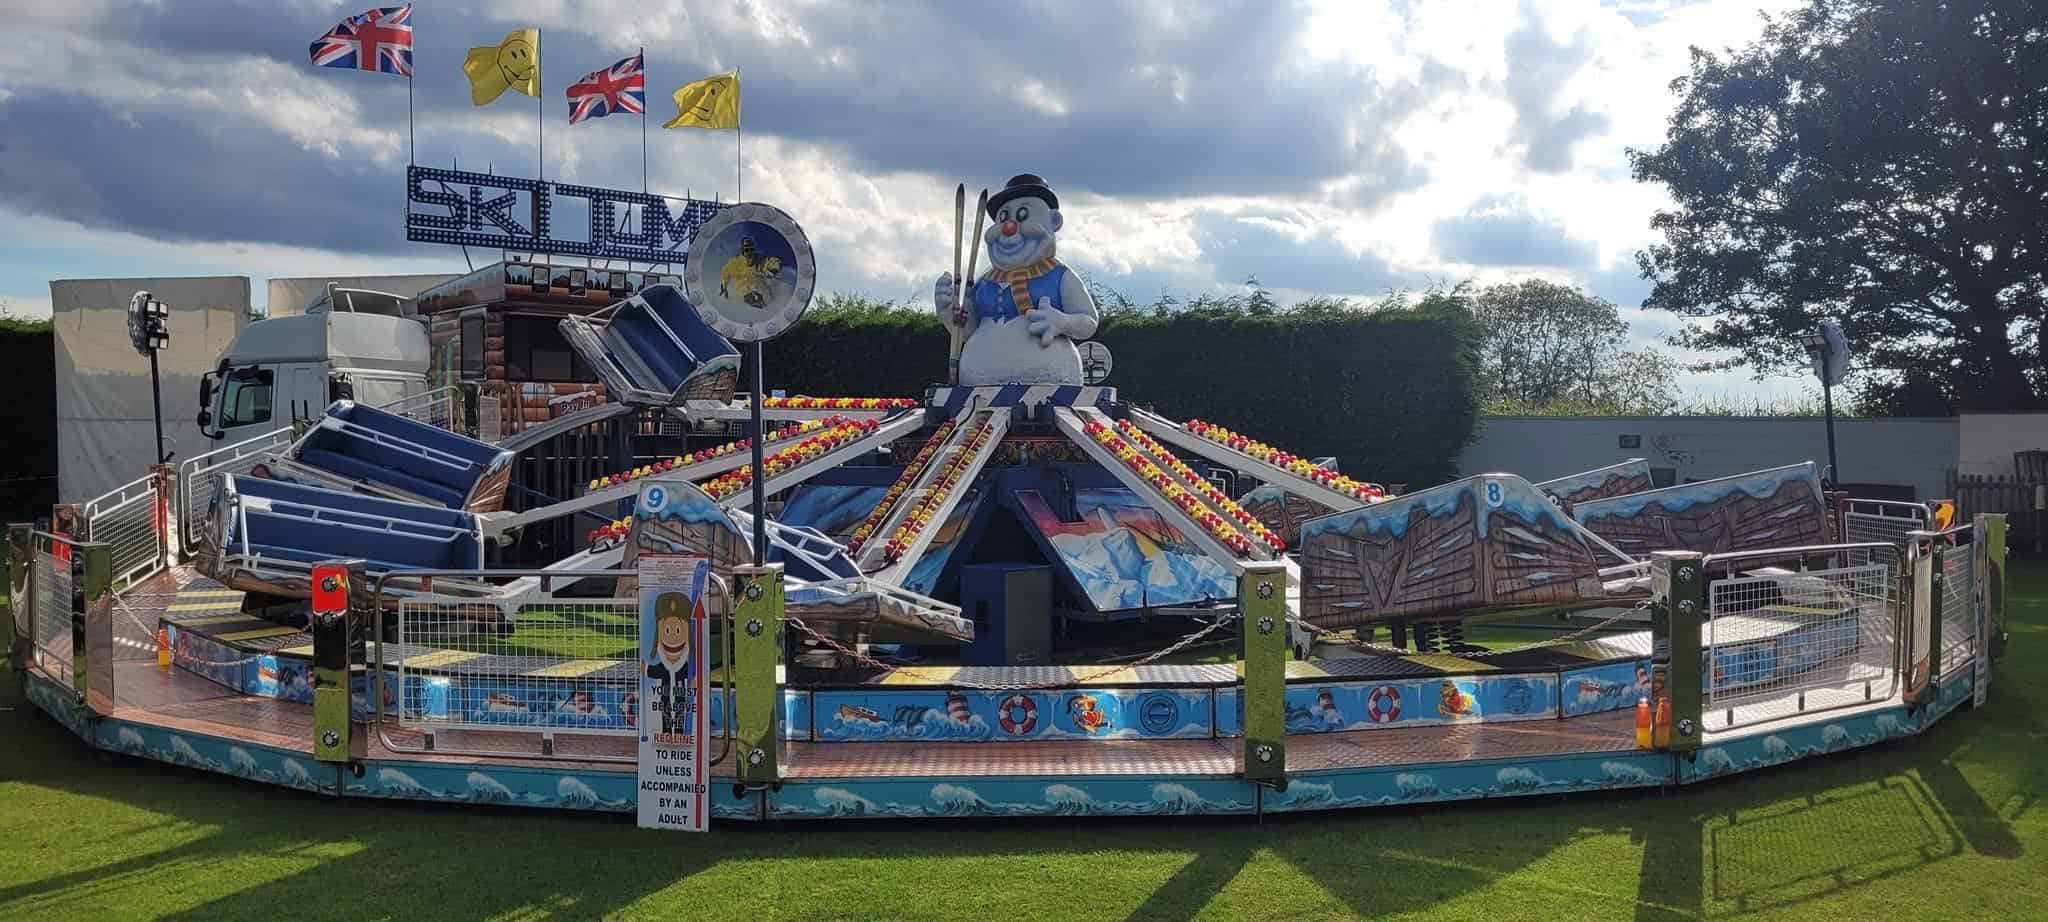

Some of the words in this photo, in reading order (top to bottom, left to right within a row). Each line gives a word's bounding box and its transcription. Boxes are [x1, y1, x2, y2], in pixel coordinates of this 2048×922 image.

[408, 166, 551, 240] SKI
[647, 487, 664, 507] 9
[1487, 482, 1501, 502] 8
[672, 687, 697, 697] MUST
[651, 702, 663, 711] BE
[664, 702, 697, 713] ABOVE
[664, 718, 683, 729] THE
[656, 750, 668, 759] TO
[670, 750, 693, 761] RIDE
[655, 765, 692, 776] UNLESS
[641, 781, 706, 794] ACCOMPANIED
[659, 798, 671, 808] BY
[674, 799, 688, 809] AN
[658, 813, 688, 825] ADULT
